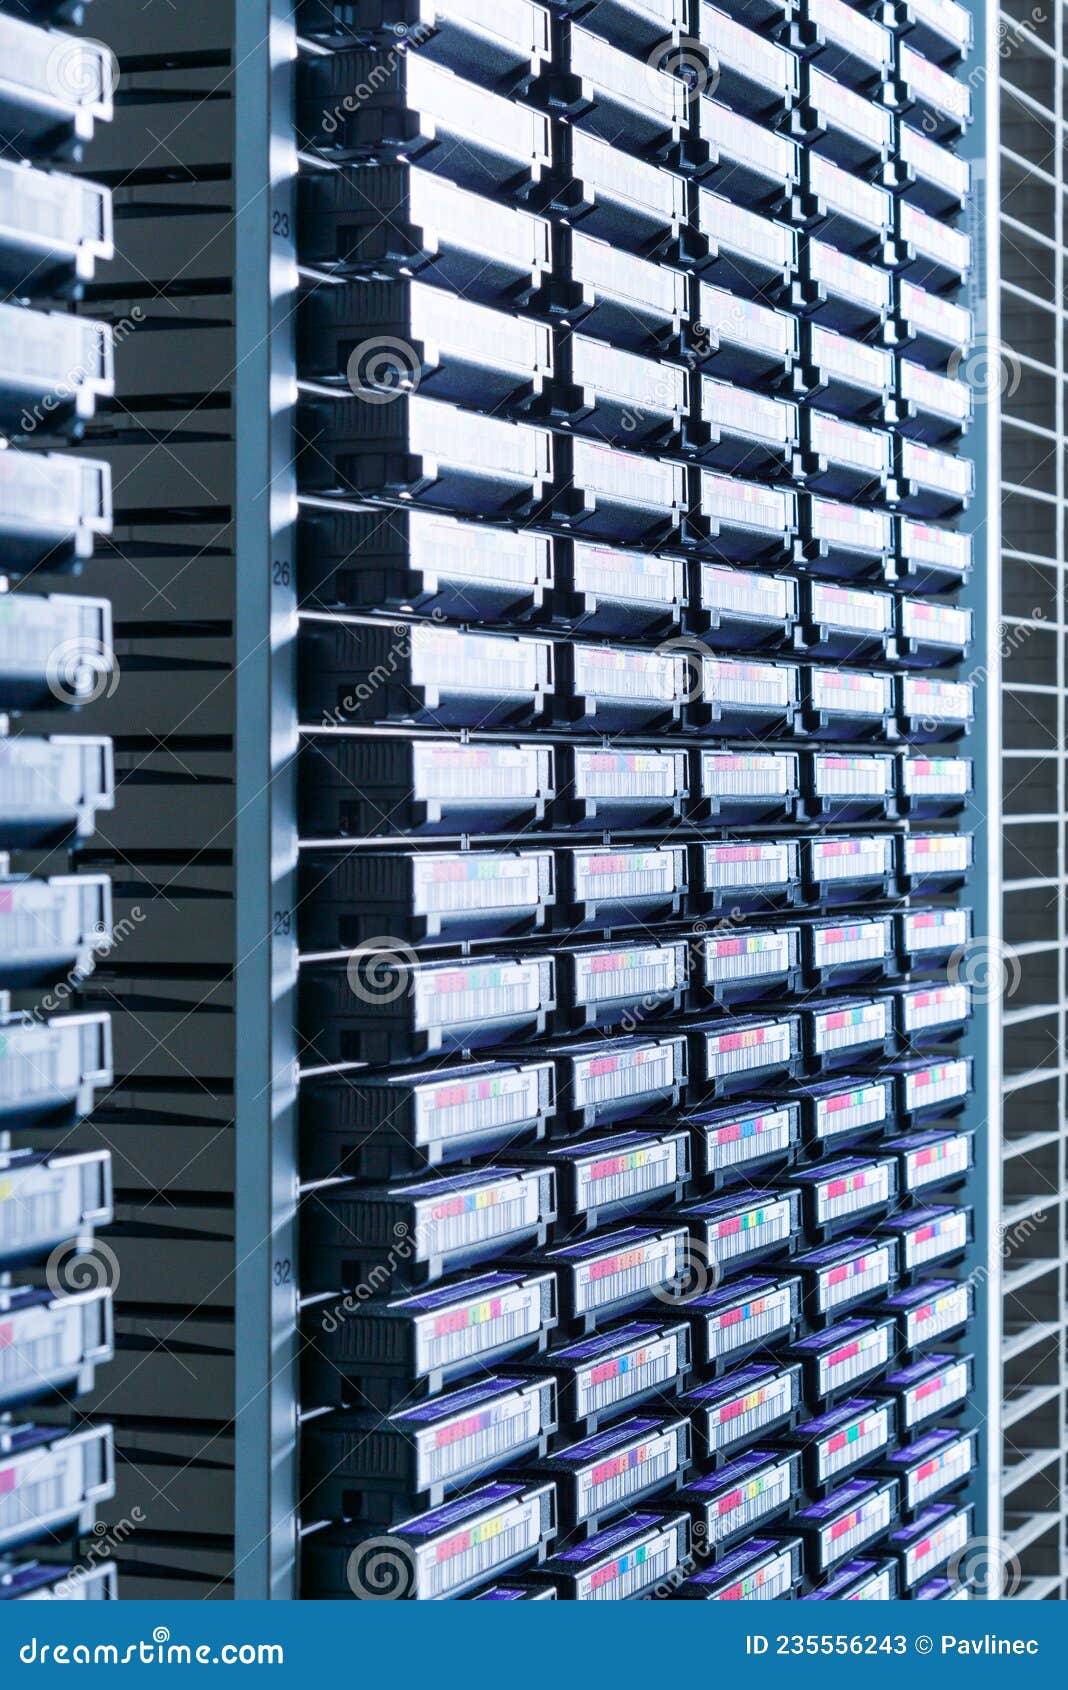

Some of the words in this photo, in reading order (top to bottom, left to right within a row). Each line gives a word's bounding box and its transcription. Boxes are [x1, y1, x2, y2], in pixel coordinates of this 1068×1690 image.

[272, 210, 289, 239] 23
[273, 560, 290, 586] 26
[274, 911, 290, 936] 29
[274, 1259, 291, 1286] 32
